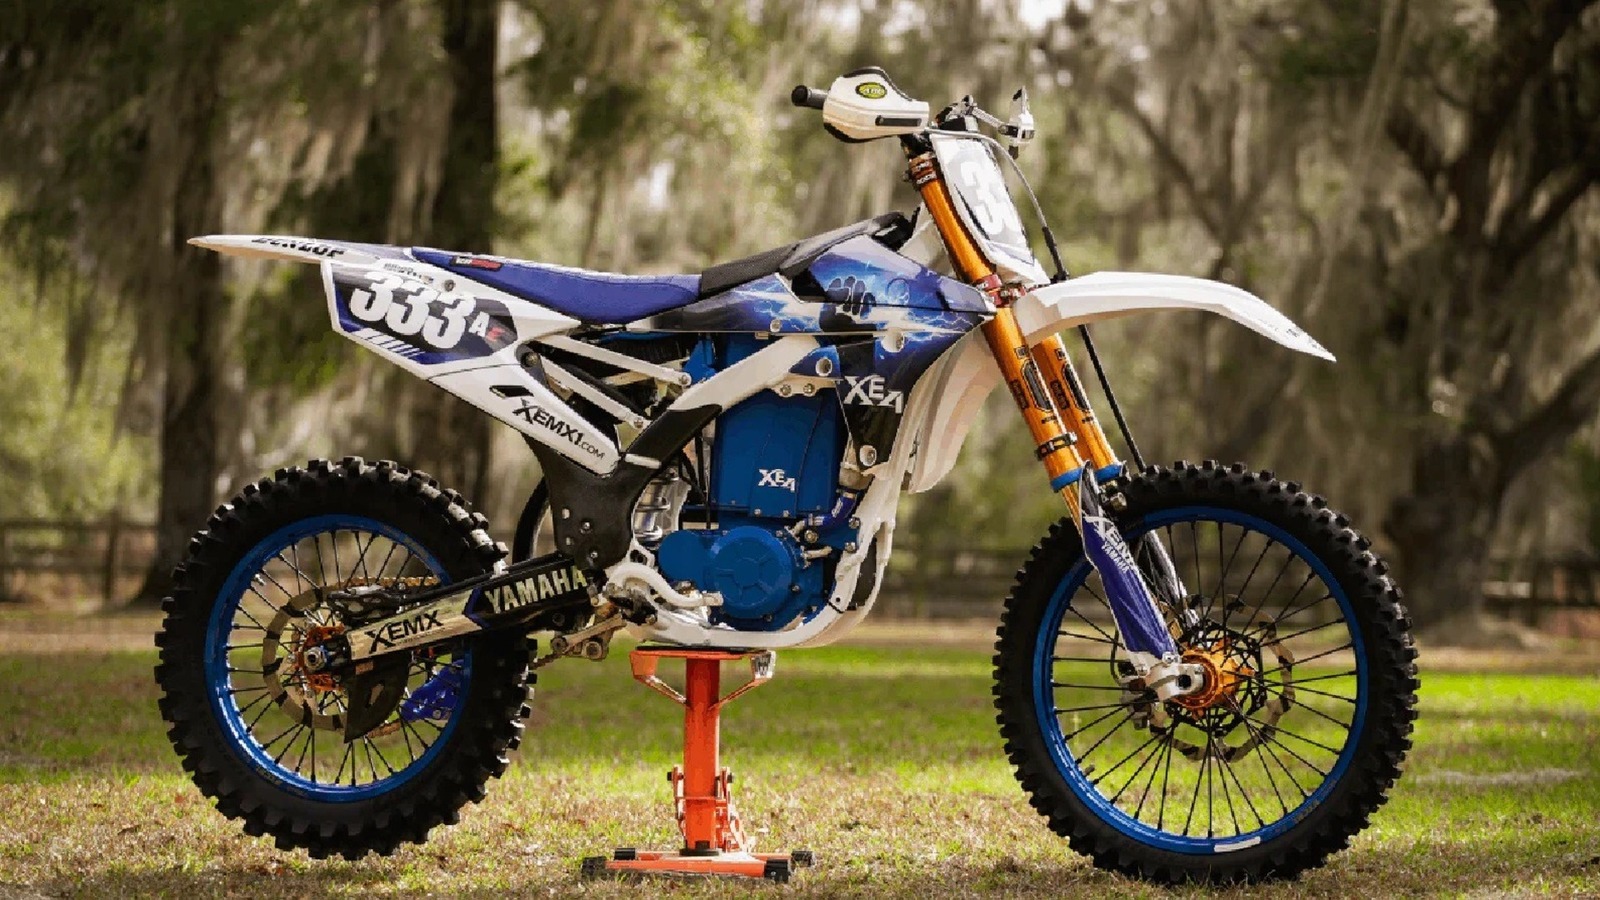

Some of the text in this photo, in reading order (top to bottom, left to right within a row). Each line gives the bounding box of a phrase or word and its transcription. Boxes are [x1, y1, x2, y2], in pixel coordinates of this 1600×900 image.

[349, 271, 476, 349] 333
[485, 565, 588, 614] YAMAHA
[364, 610, 444, 654] XEMX
